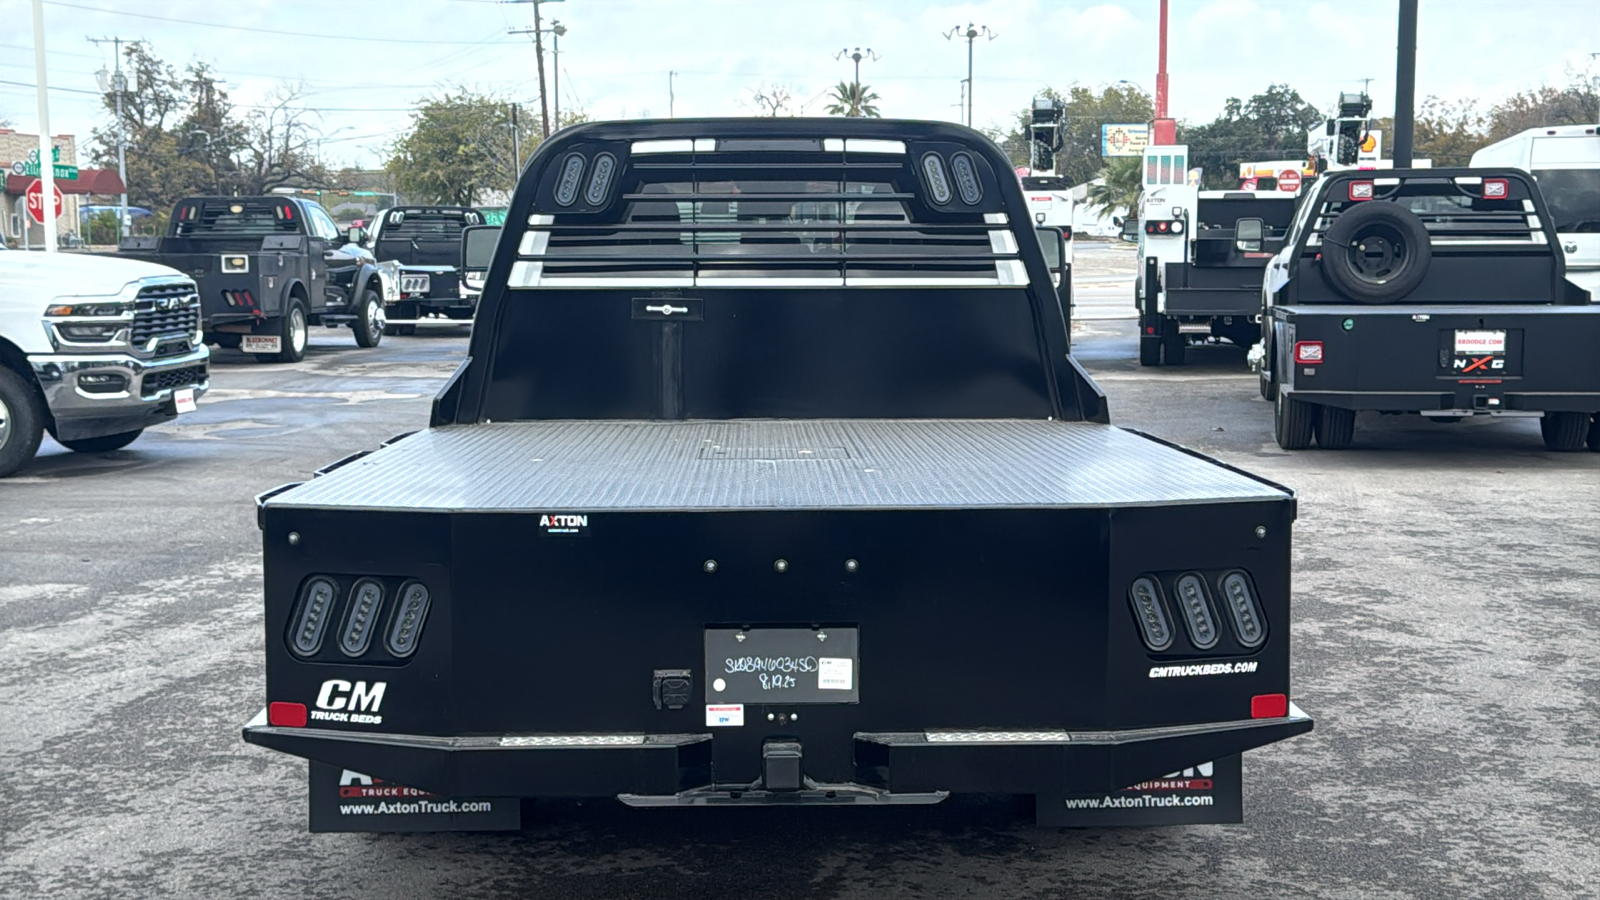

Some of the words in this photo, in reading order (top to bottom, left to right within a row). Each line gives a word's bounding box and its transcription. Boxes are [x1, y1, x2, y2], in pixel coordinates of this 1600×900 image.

[29, 192, 60, 210] STP
[540, 515, 588, 526] AXTON
[1149, 662, 1258, 678] CMTRUCKBEDS.COM
[315, 679, 387, 712] CM
[310, 711, 349, 722] TRUCK
[350, 714, 382, 724] BEDS
[340, 800, 491, 814] www.AxtonTruck.com
[1066, 794, 1214, 808] www.AxtonTruck.com
